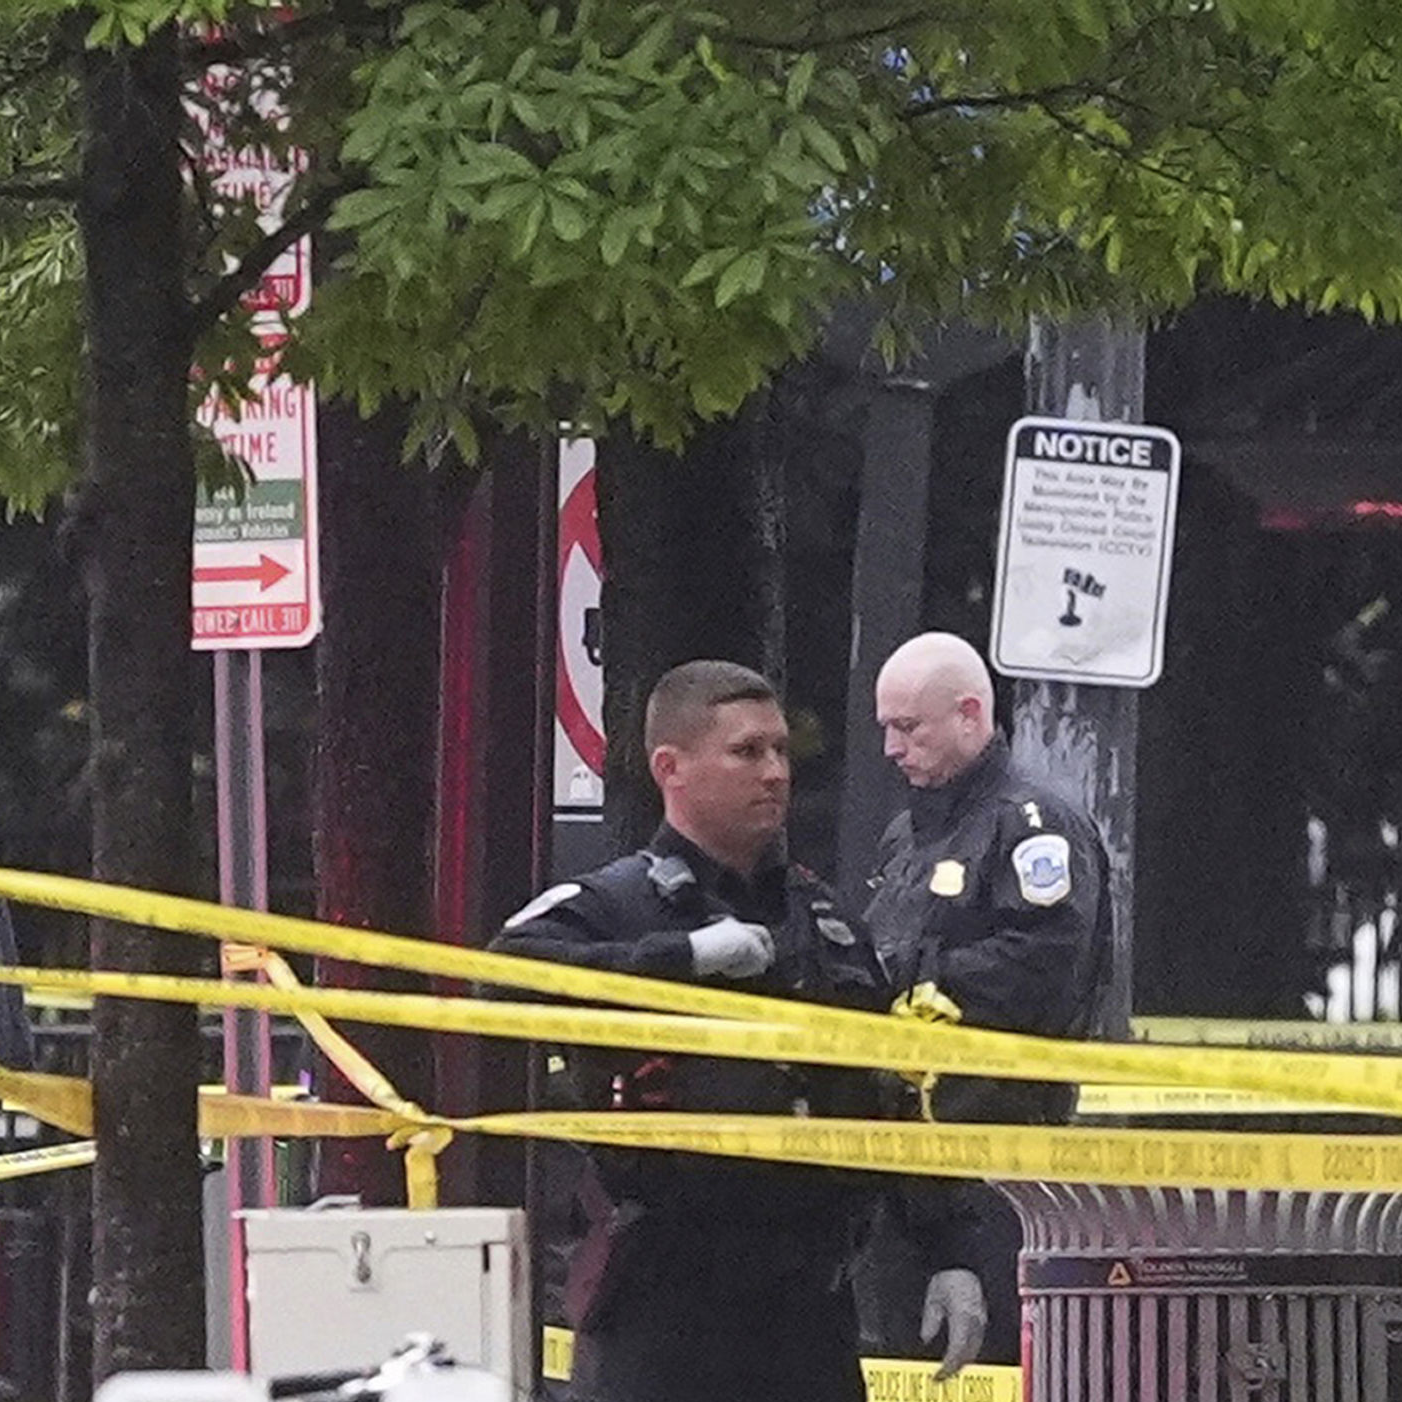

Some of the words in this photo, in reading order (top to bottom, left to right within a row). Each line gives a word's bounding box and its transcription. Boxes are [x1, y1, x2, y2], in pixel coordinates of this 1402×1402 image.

[1034, 431, 1153, 467] NOTICE
[241, 609, 278, 633] CALL
[868, 1368, 901, 1401] POLICE
[902, 1371, 924, 1402] LINE
